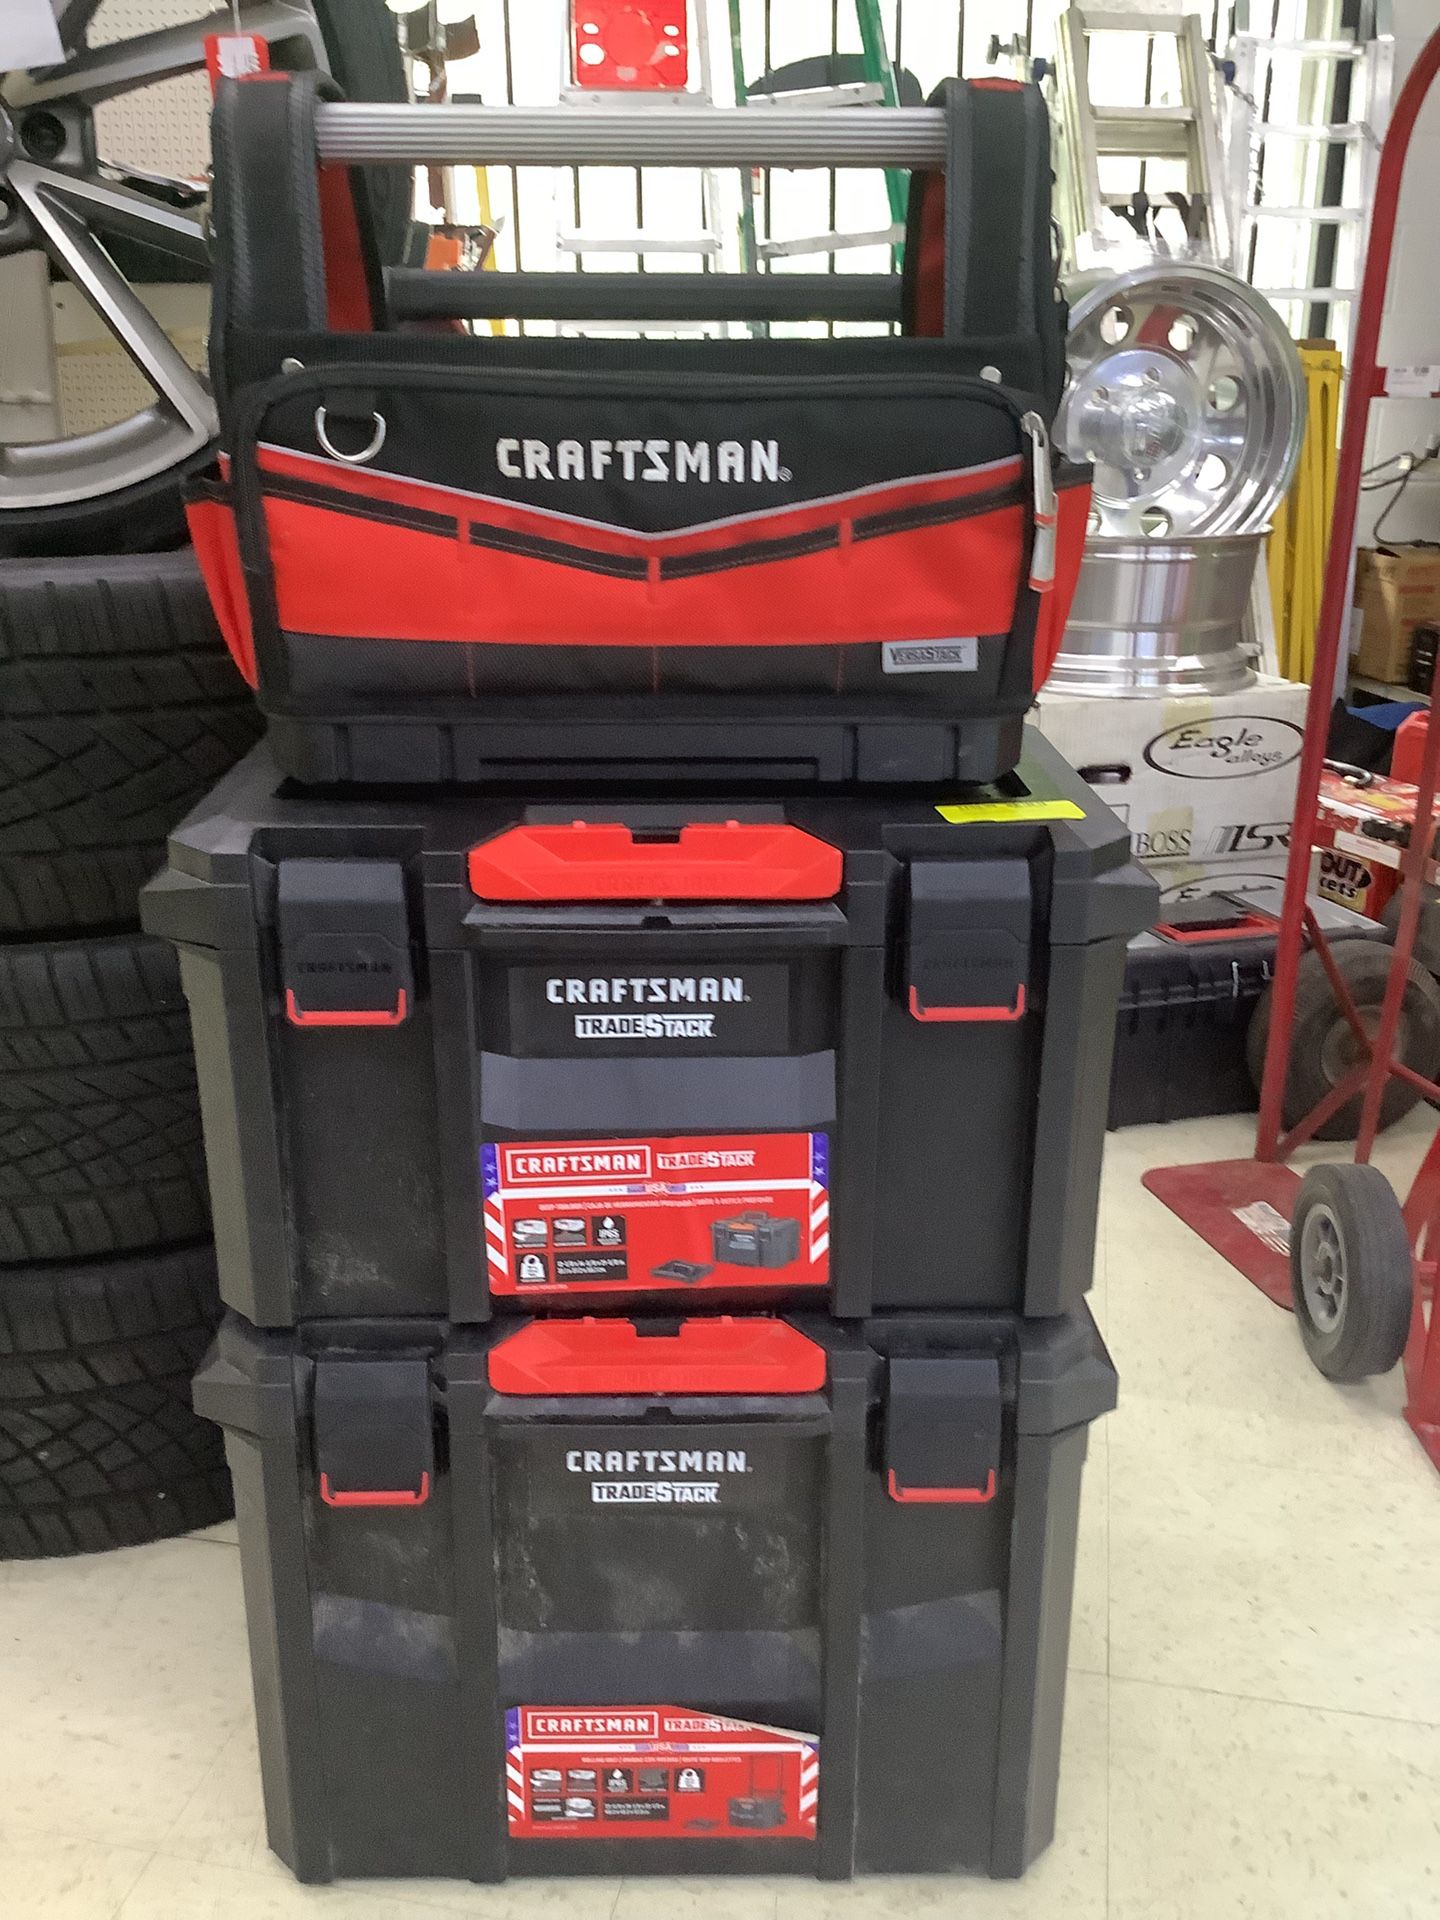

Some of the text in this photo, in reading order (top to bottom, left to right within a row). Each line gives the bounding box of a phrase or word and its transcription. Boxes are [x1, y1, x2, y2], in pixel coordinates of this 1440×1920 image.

[496, 437, 780, 484] CRAFTSMAN
[1169, 728, 1263, 758] Eagle
[1224, 750, 1283, 766] alloys
[1136, 828, 1192, 856] BOSS
[546, 977, 745, 1004] CRAFTSMAN
[515, 1152, 642, 1175] CRAFTSMAN
[566, 1450, 746, 1473] CRAFTSMAN
[535, 1717, 649, 1733] CRAFTSMAN
